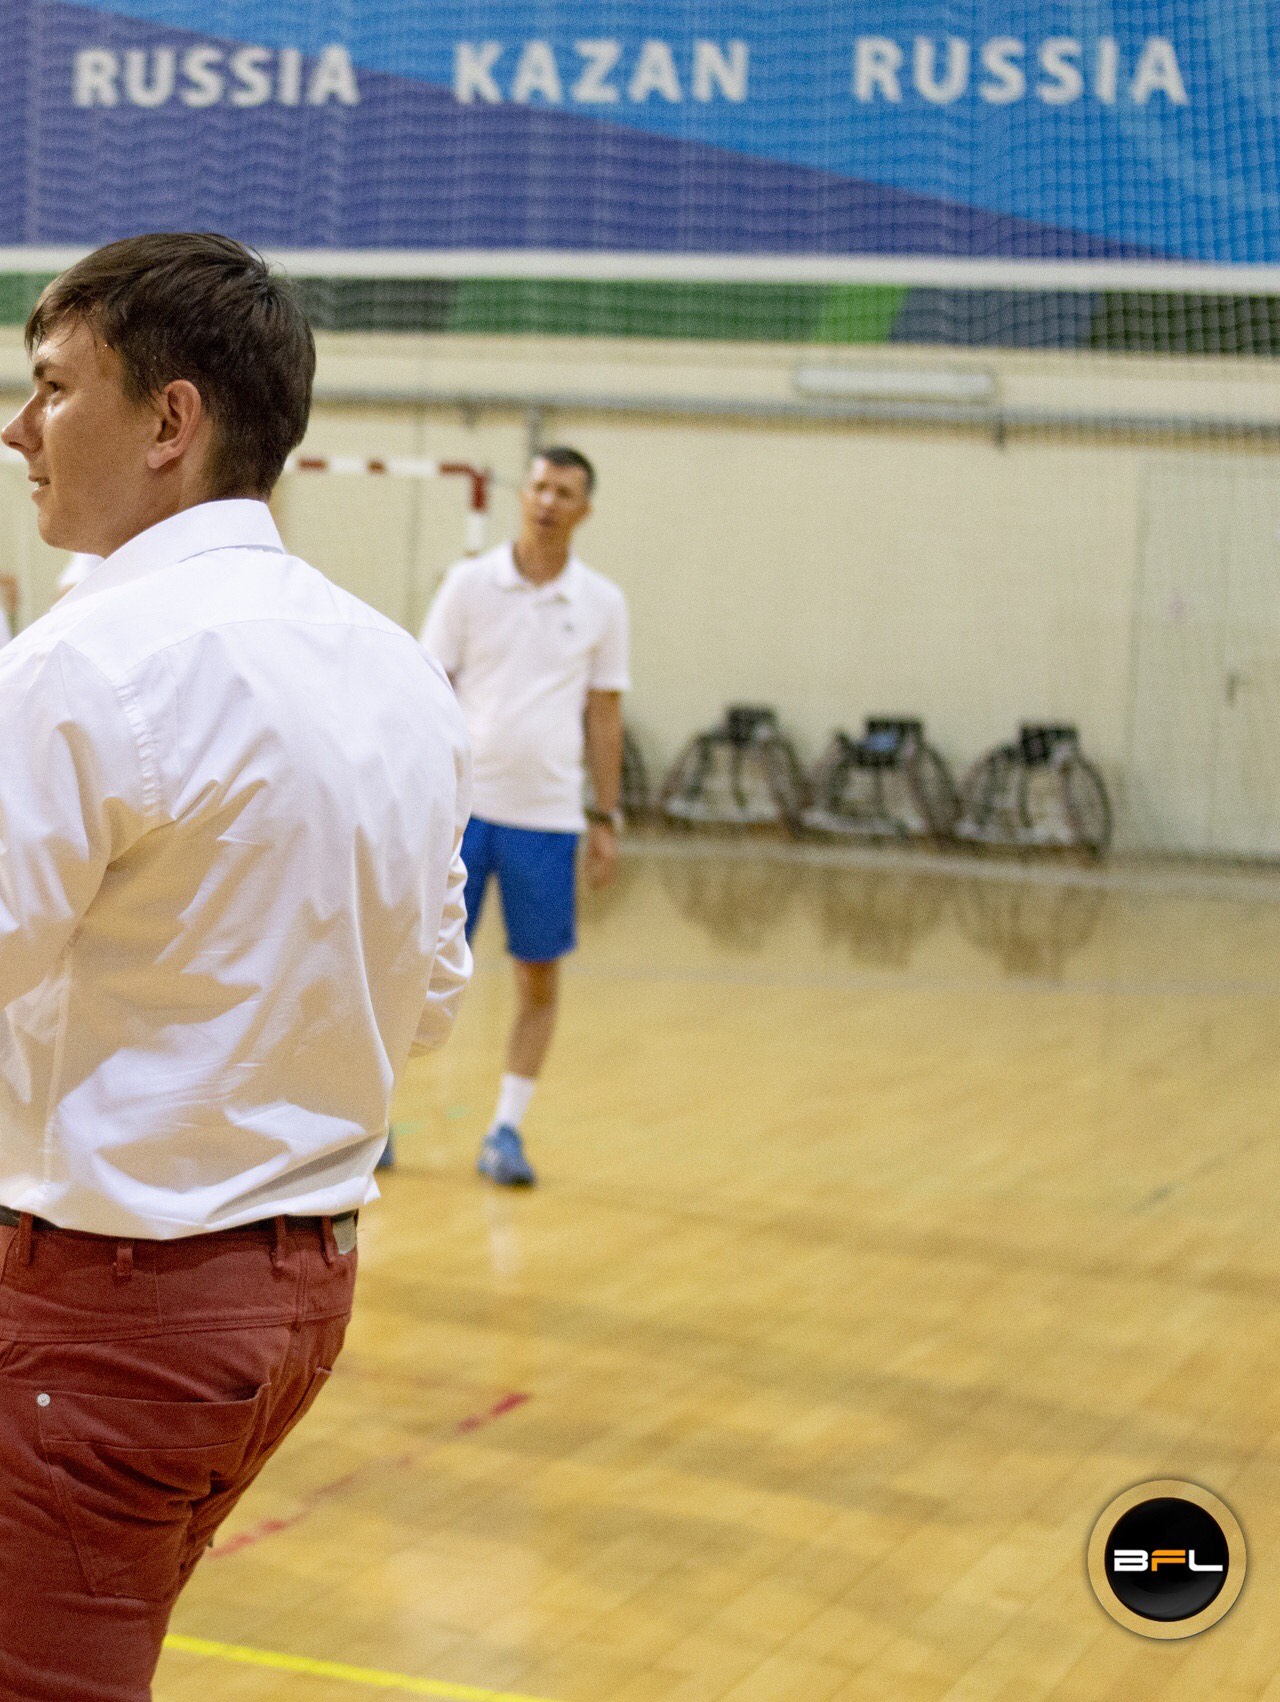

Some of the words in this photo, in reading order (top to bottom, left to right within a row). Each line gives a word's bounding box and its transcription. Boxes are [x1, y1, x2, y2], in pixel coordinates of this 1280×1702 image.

[74, 45, 358, 108] RUSSIA
[454, 40, 748, 104] KAZAN
[855, 36, 1187, 106] RUSSIA
